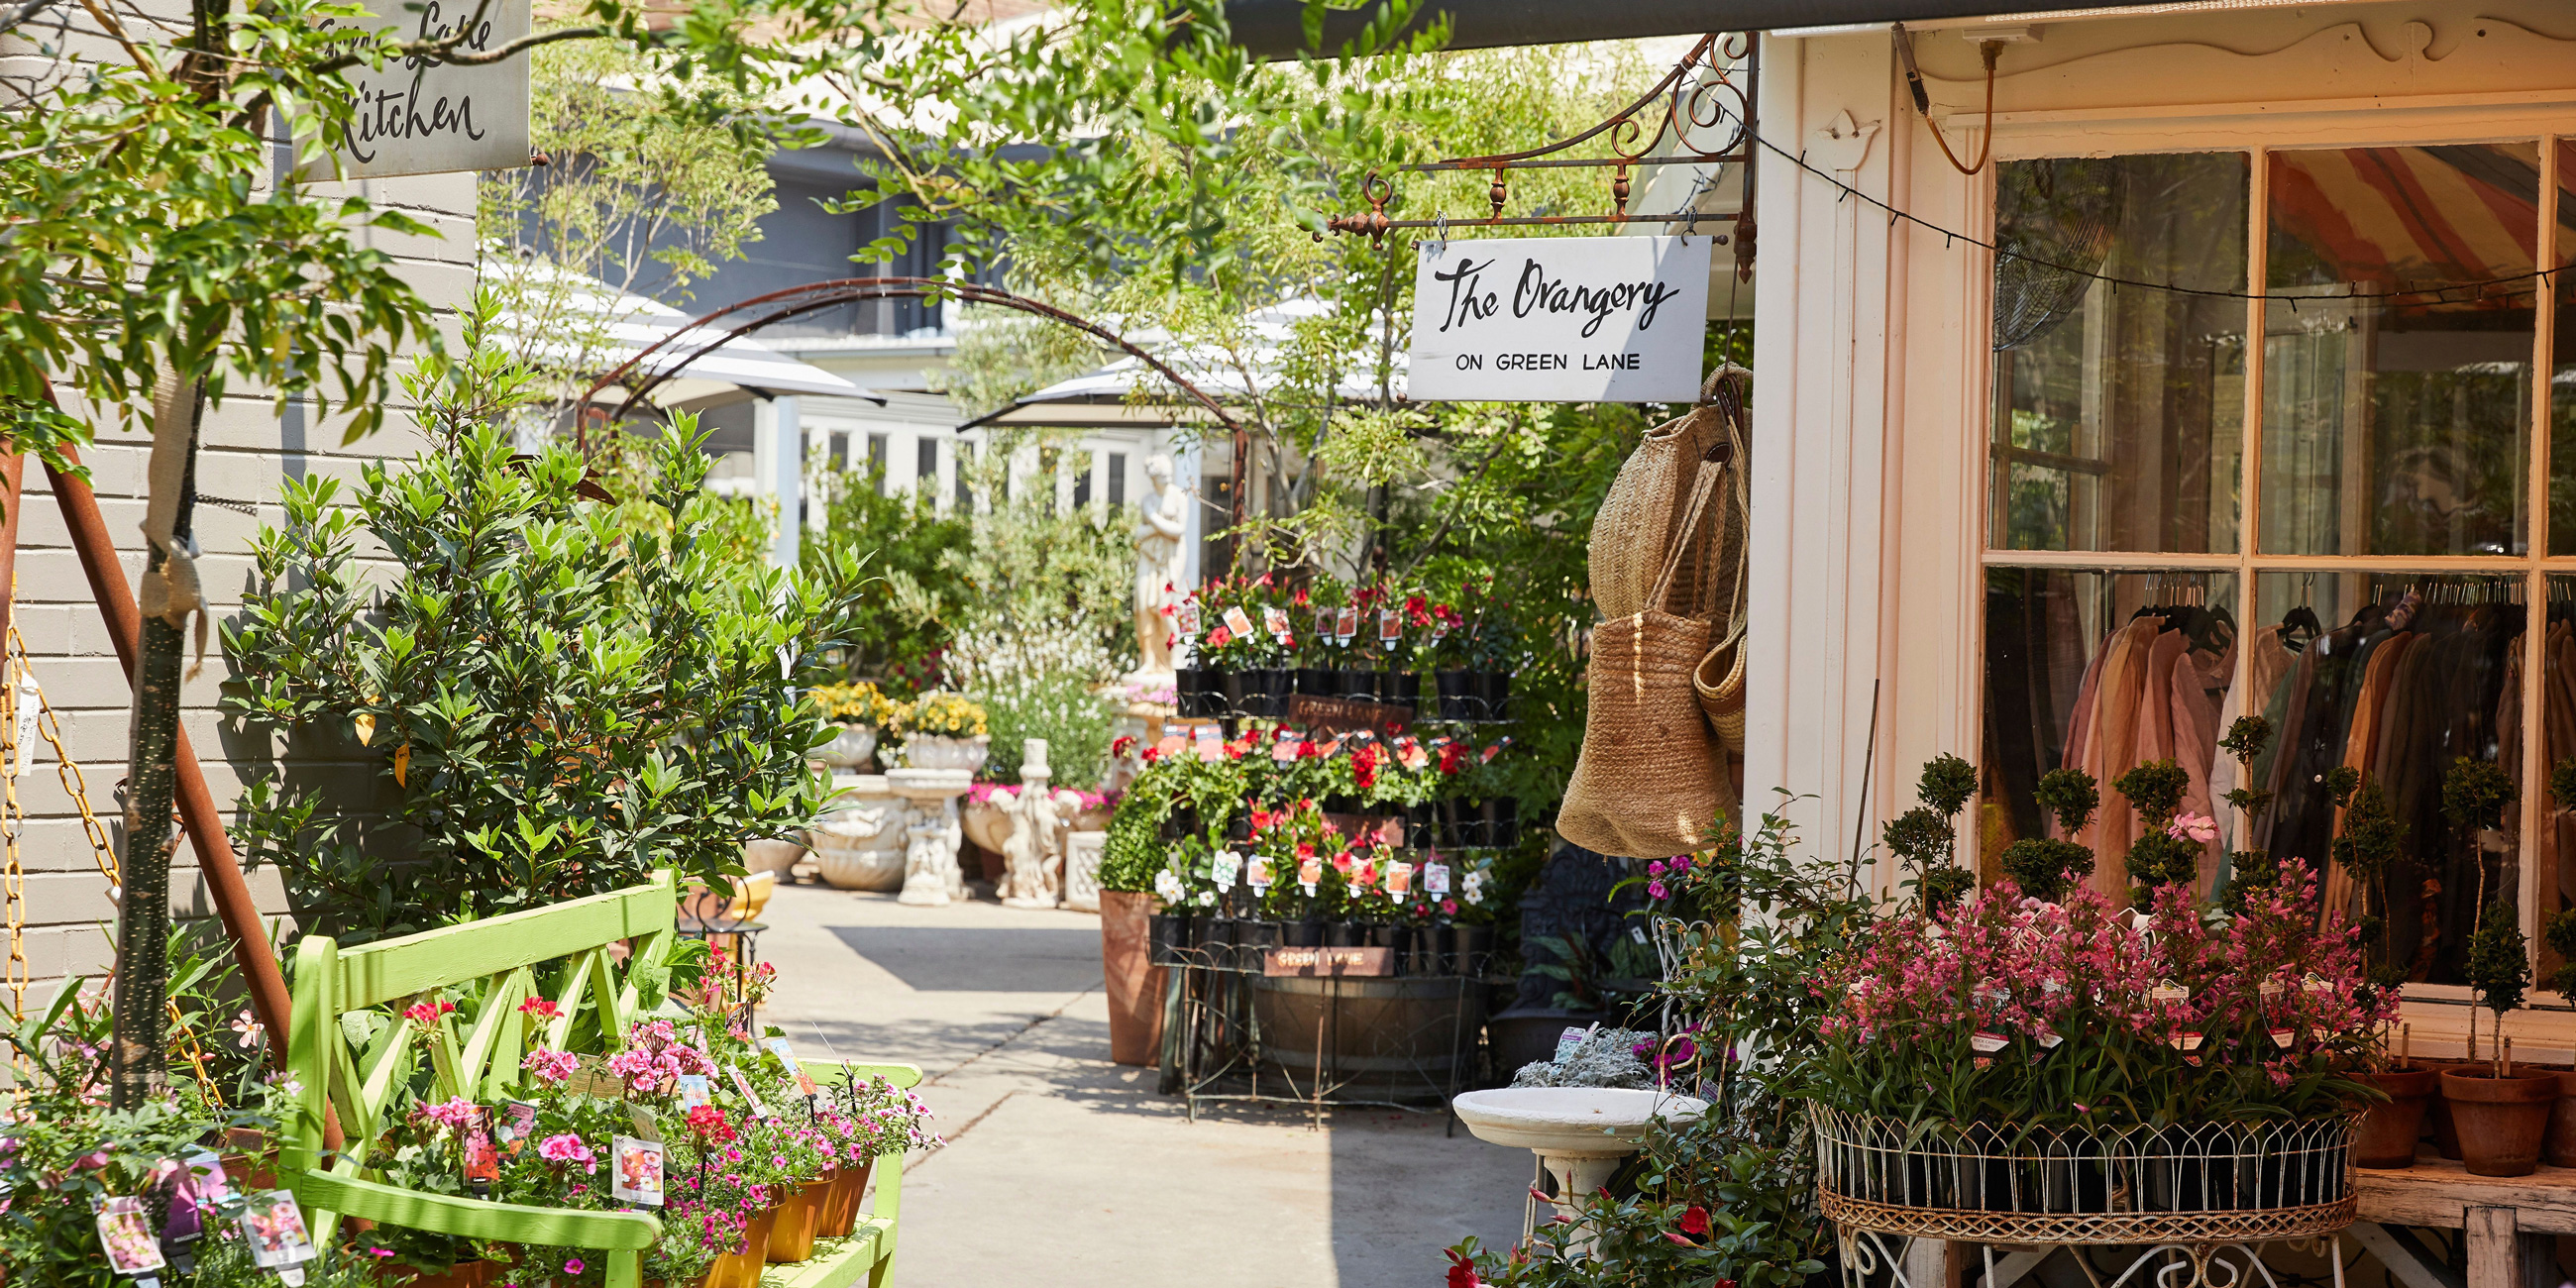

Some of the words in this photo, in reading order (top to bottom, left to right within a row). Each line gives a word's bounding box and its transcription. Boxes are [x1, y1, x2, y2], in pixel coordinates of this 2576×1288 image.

[1435, 258, 1498, 333] The
[1513, 258, 1681, 339] Orangery
[1455, 354, 1483, 371] ON
[1496, 353, 1567, 371] GREEN
[1583, 353, 1641, 370] LANE
[1277, 951, 1320, 968] GREEN
[1328, 951, 1364, 967] LANE
